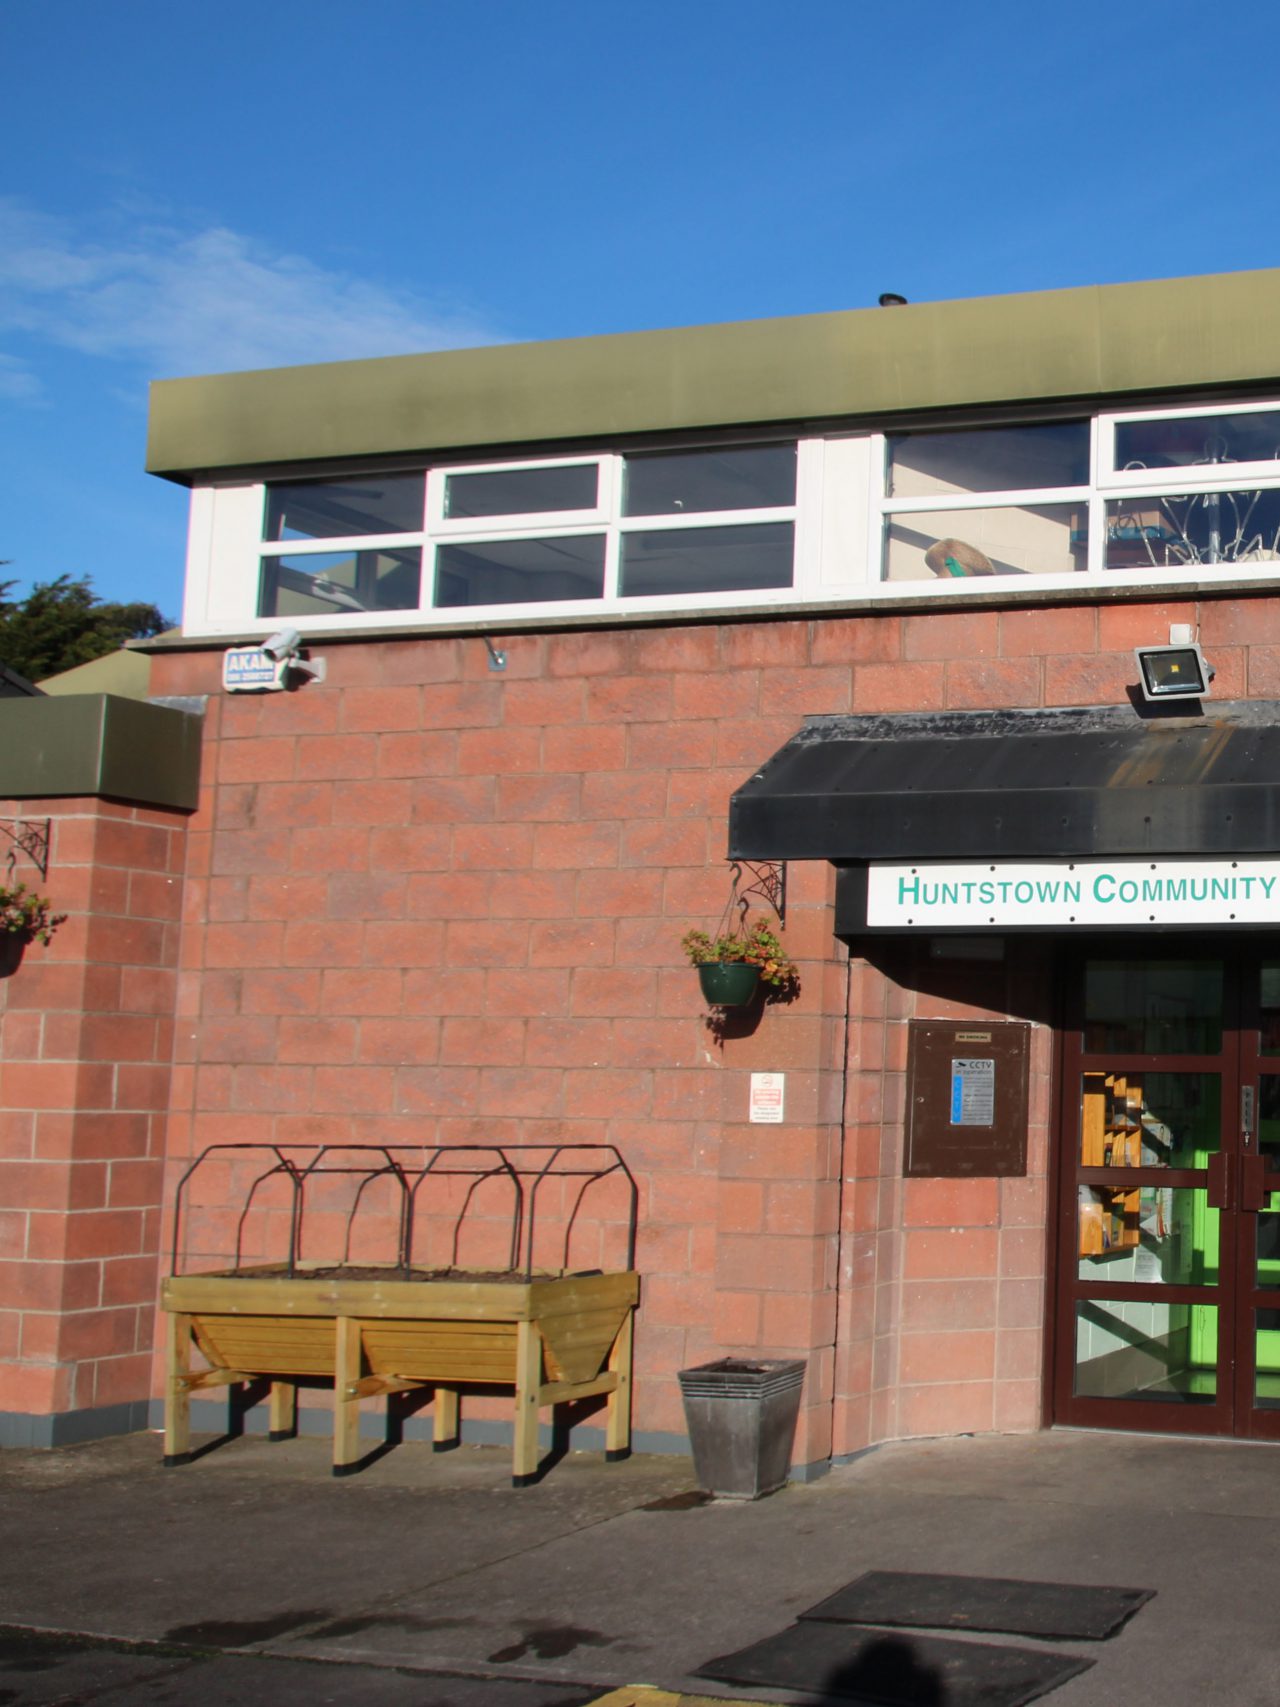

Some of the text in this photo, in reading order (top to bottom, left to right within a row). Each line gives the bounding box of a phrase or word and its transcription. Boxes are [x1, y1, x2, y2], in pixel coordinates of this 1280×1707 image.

[898, 876, 1081, 905] HUNTSTOWN
[1093, 874, 1276, 903] COMMUNITY
[969, 1061, 992, 1069] CCTV
